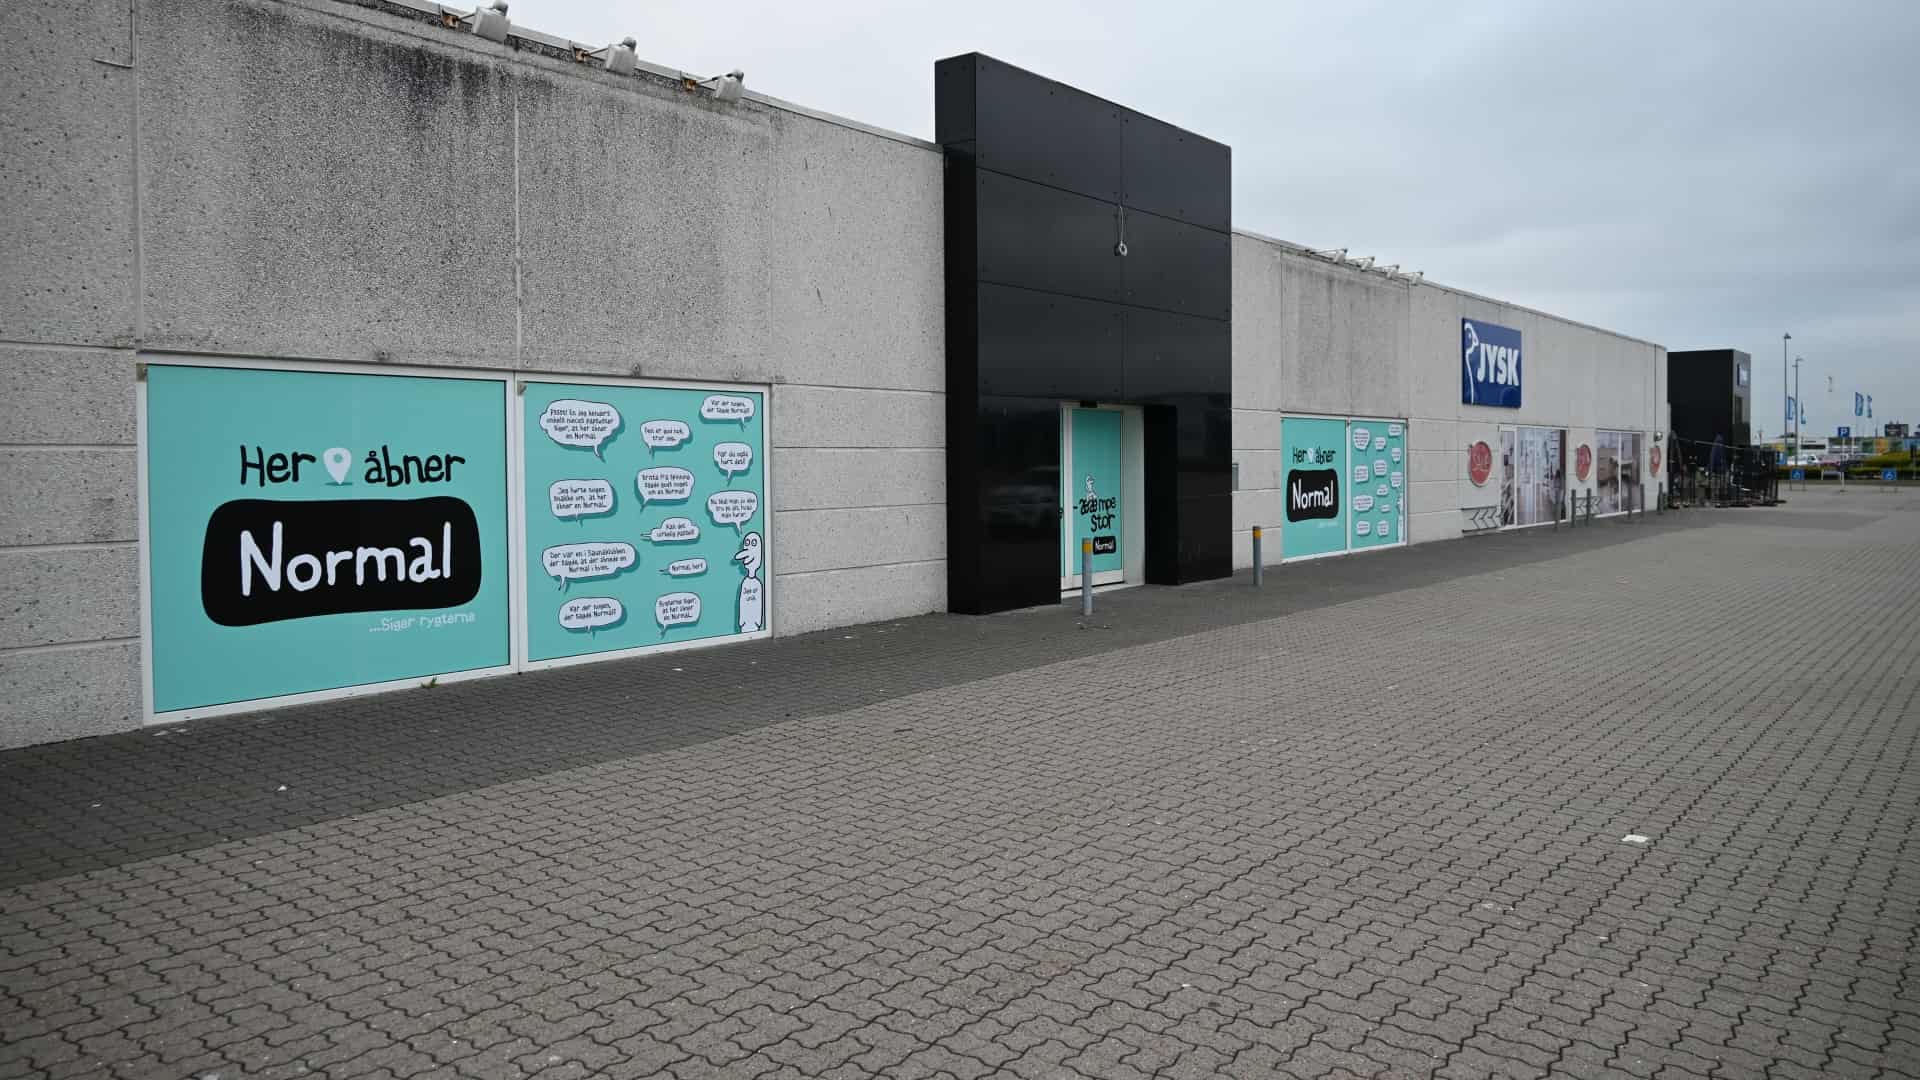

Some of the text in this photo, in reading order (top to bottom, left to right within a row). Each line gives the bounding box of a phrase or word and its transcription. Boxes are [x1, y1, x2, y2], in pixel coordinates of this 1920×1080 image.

[1477, 342, 1520, 387] JYSK
[240, 444, 466, 487] Her åbner
[1292, 447, 1307, 465] Her
[1292, 478, 1334, 512] Normal
[240, 520, 451, 597] Normal
